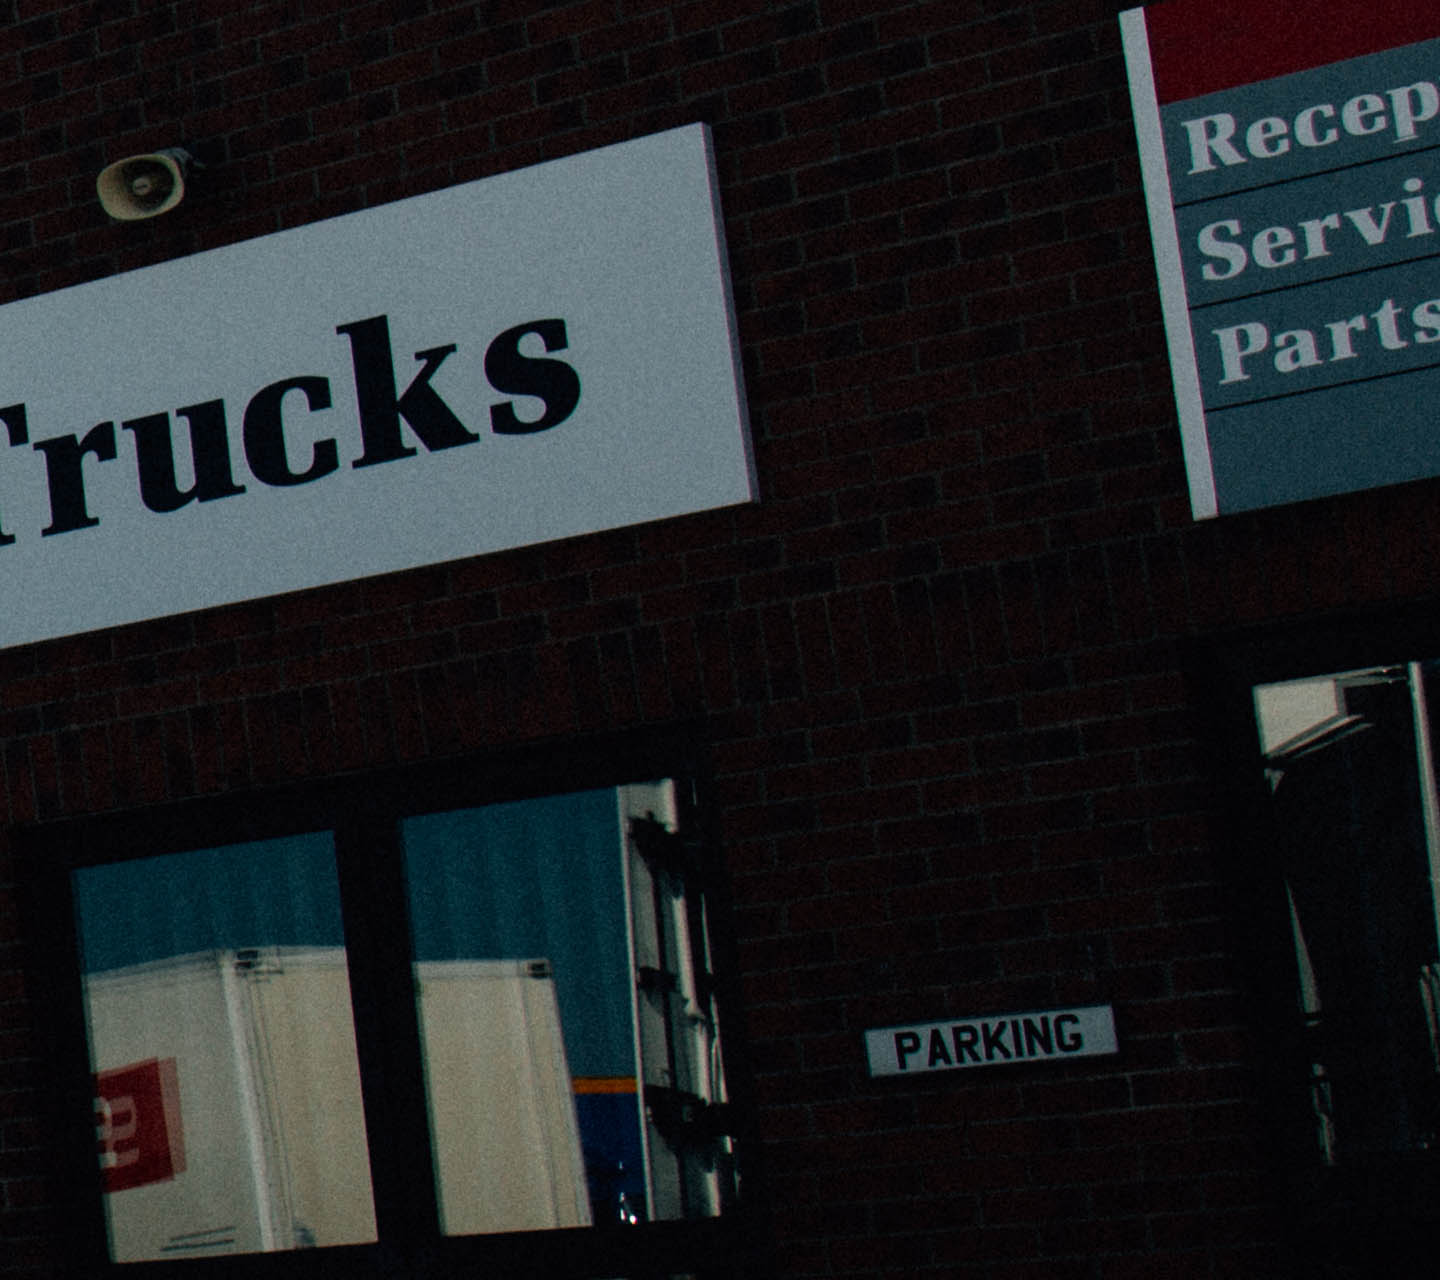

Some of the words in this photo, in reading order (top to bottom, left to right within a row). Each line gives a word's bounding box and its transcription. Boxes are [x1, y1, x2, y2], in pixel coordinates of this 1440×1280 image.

[1196, 177, 1440, 282] Servi
[1212, 299, 1440, 385] Parts
[894, 1013, 1082, 1071] PARKING
